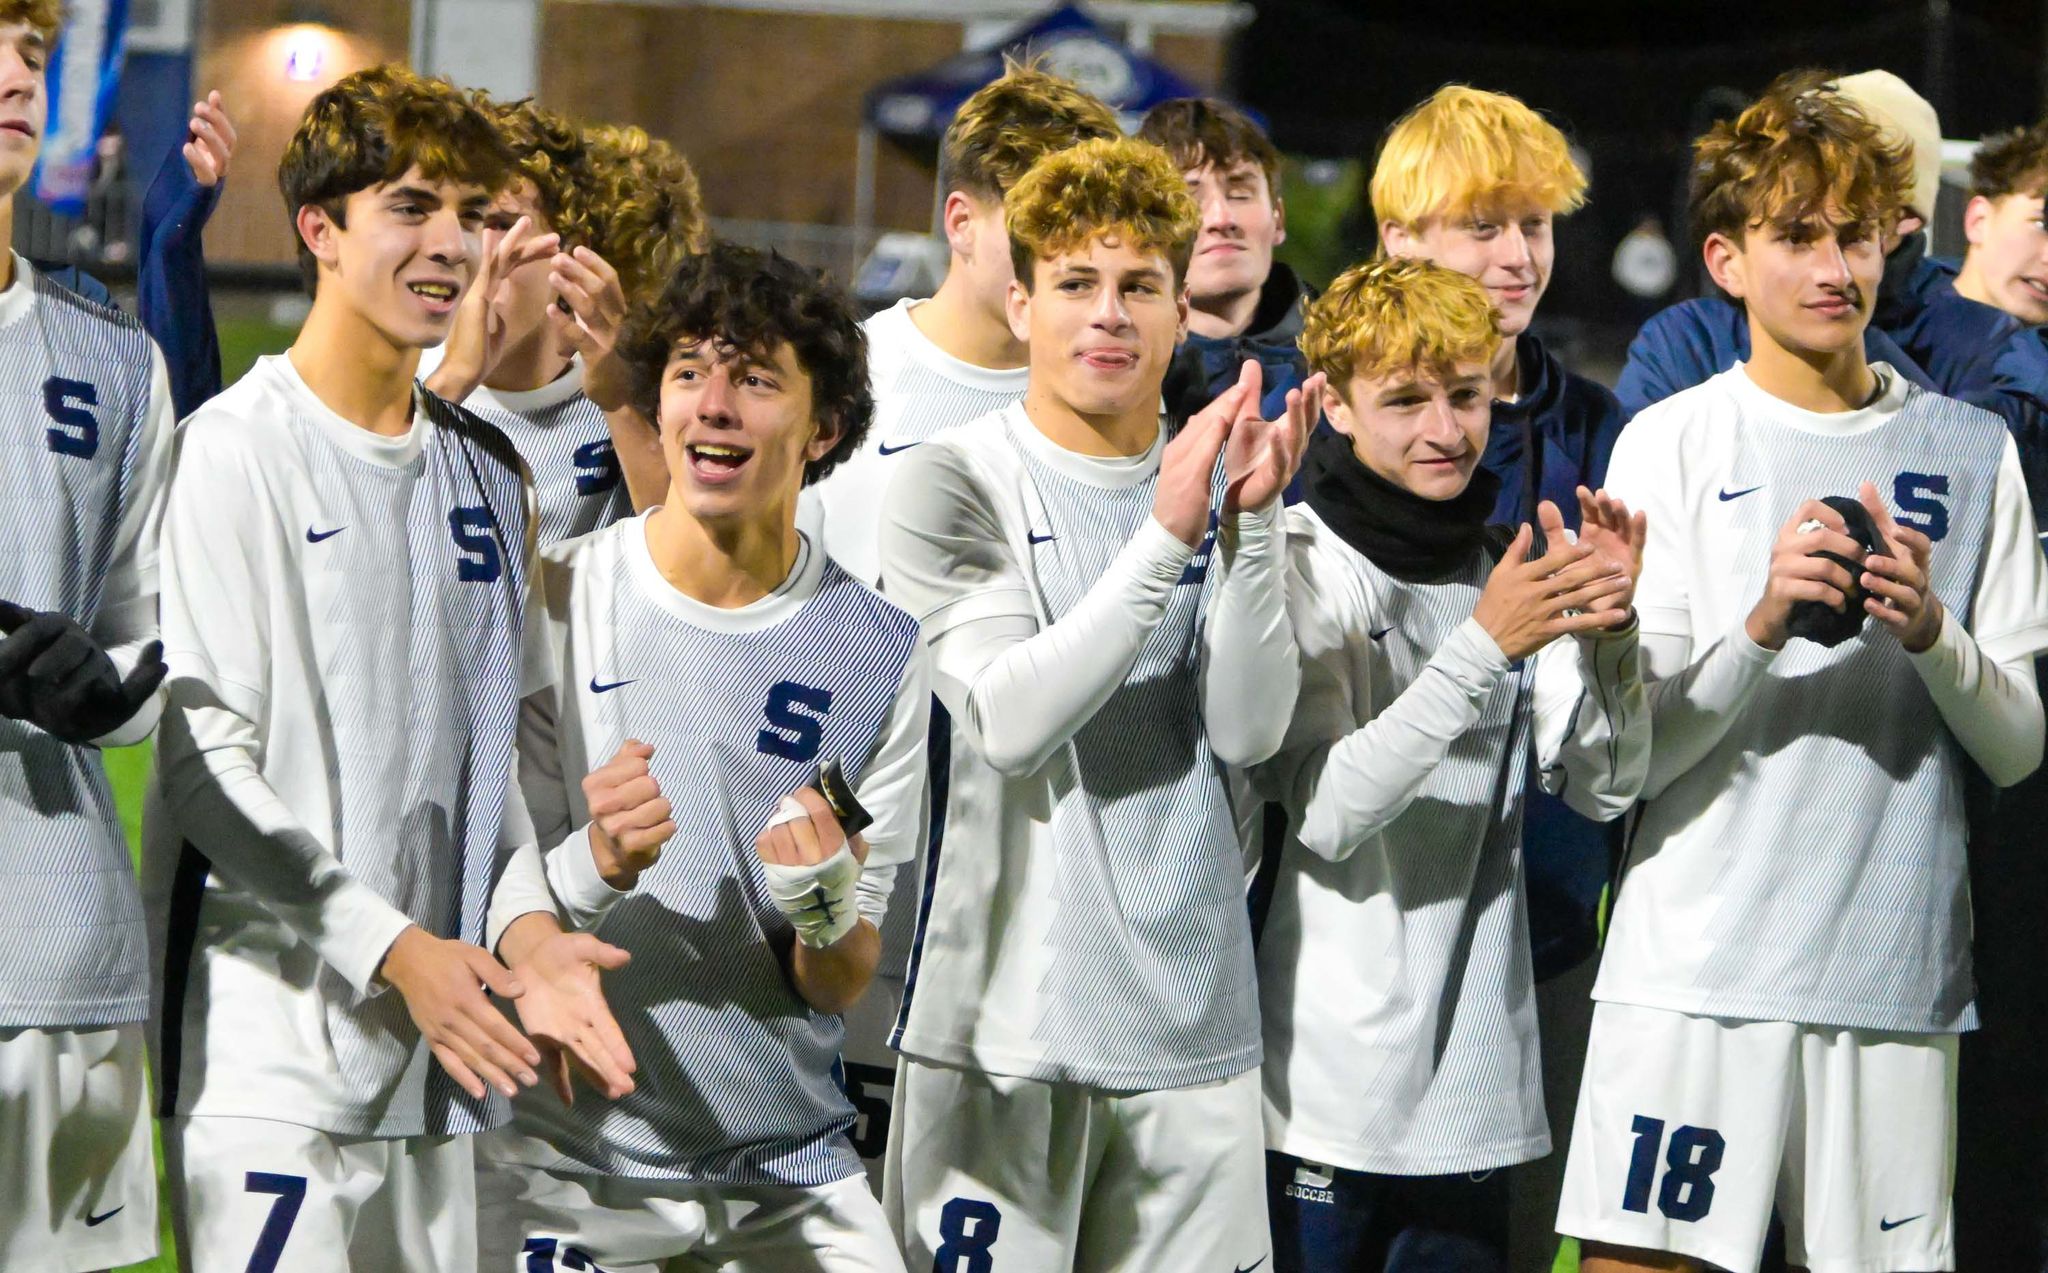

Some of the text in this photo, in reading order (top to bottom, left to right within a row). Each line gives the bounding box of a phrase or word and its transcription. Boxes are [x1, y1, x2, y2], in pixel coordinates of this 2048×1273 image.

[44, 377, 98, 460] S
[574, 438, 621, 496] S
[448, 506, 500, 581] S
[1894, 473, 1949, 542] S
[757, 681, 831, 763] S
[1285, 1184, 1335, 1204] SOCCER
[1622, 1114, 1725, 1223] 18
[245, 1171, 307, 1273] 7
[933, 1197, 1001, 1273] 8
